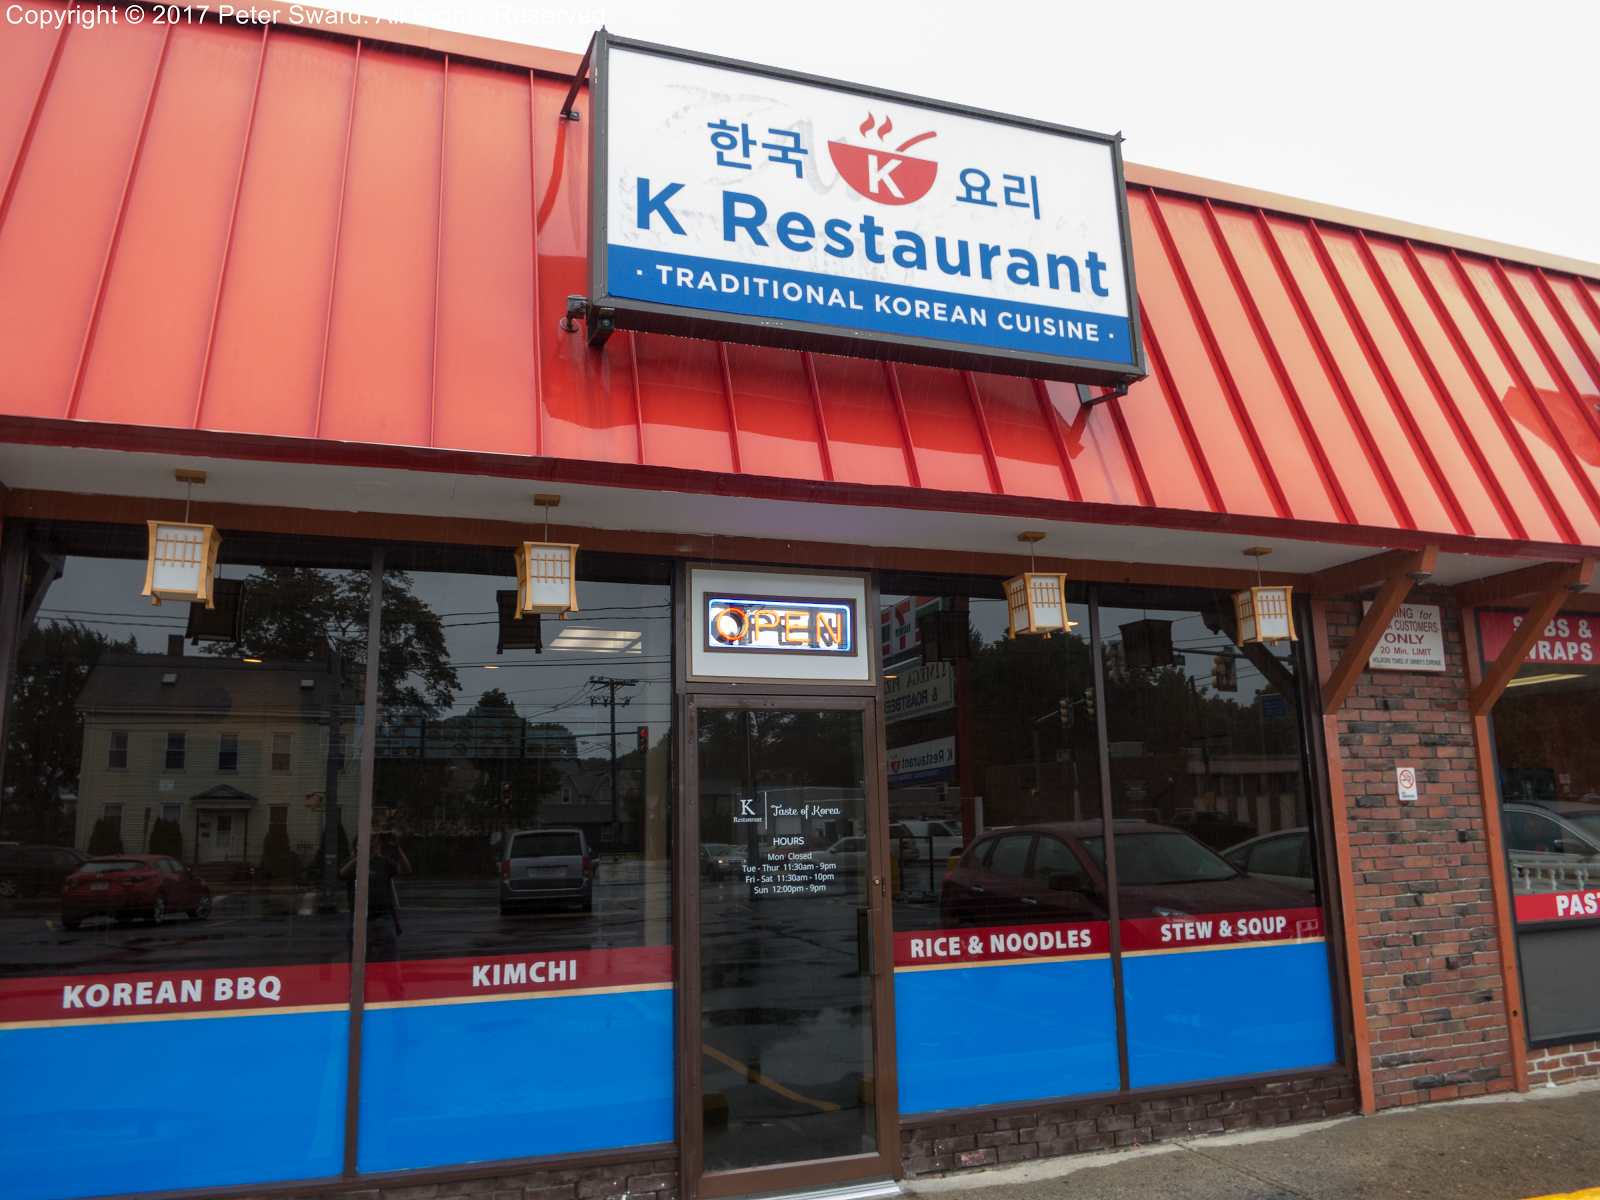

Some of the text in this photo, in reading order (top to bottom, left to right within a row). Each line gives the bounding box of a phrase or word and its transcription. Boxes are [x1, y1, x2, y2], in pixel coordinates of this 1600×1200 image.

[707, 119, 808, 179] 한국
[868, 154, 905, 200] K
[955, 166, 1041, 220] 요리
[636, 177, 1110, 298] K Restaurant
[656, 264, 1100, 342] TRADITIONAL KOREAN CUISINE
[716, 606, 843, 645] OPEN
[1419, 610, 1433, 620] for
[1513, 616, 1592, 638] SBS &
[1384, 632, 1425, 645] ONLY
[1380, 646, 1431, 656] 20 Min. LIMIT
[740, 799, 756, 815] K
[771, 804, 840, 820] Taste of Korea
[773, 837, 805, 846] HOURS
[742, 865, 756, 873] Tue
[762, 864, 780, 872] Thur
[784, 863, 814, 871] 11:30am
[820, 862, 836, 871] 9pm
[767, 852, 812, 861] Mon Closed
[754, 886, 769, 894] Sun
[772, 885, 804, 894] 12:00pm
[810, 884, 826, 893] 9pm
[761, 875, 773, 883] Sat
[777, 874, 808, 882] 11:30am
[814, 873, 835, 883] 10pm
[1160, 916, 1287, 942] STEW & SOUP
[910, 929, 1092, 958] RICE & NOODLES
[472, 959, 578, 987] KIMCHI
[62, 975, 282, 1009] KOREAN BBQ
